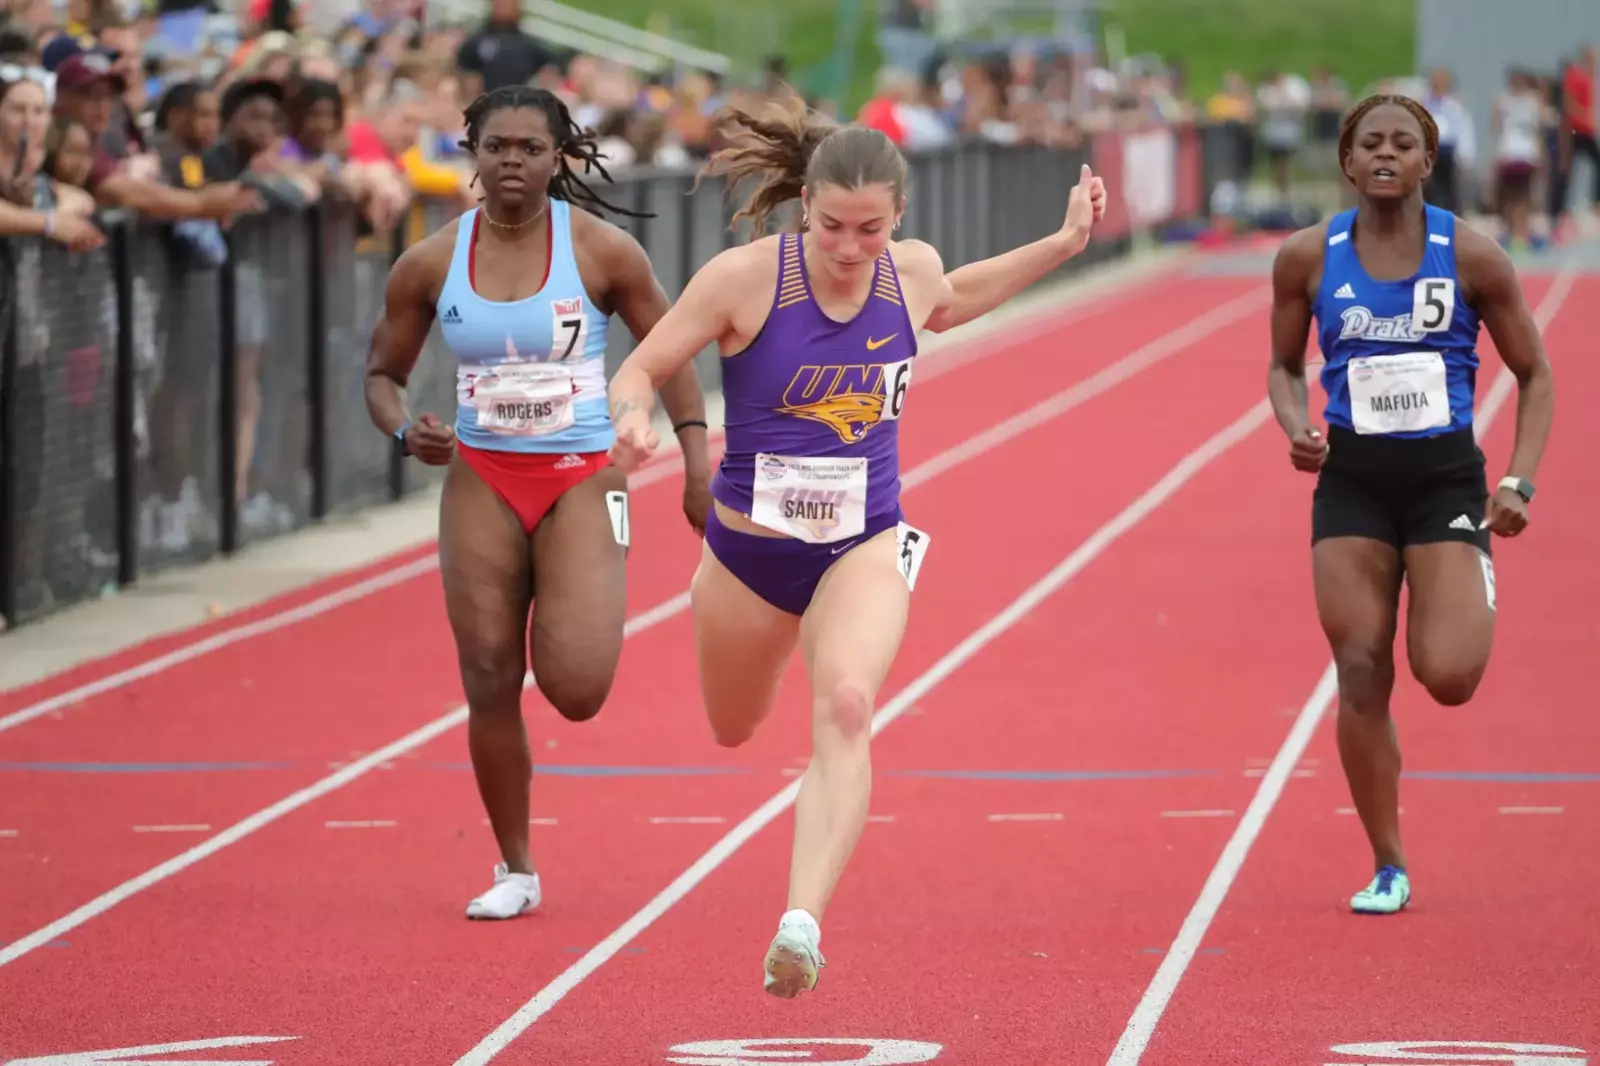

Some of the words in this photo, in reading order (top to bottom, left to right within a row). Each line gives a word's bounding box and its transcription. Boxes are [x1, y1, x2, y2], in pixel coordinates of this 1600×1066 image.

[1422, 282, 1446, 329] 5
[562, 319, 581, 361] 7
[497, 401, 552, 420] ROGERS
[891, 363, 908, 417] 6
[1370, 391, 1429, 412] MAFUTA
[613, 495, 624, 541] 7
[784, 500, 834, 520] SANTI
